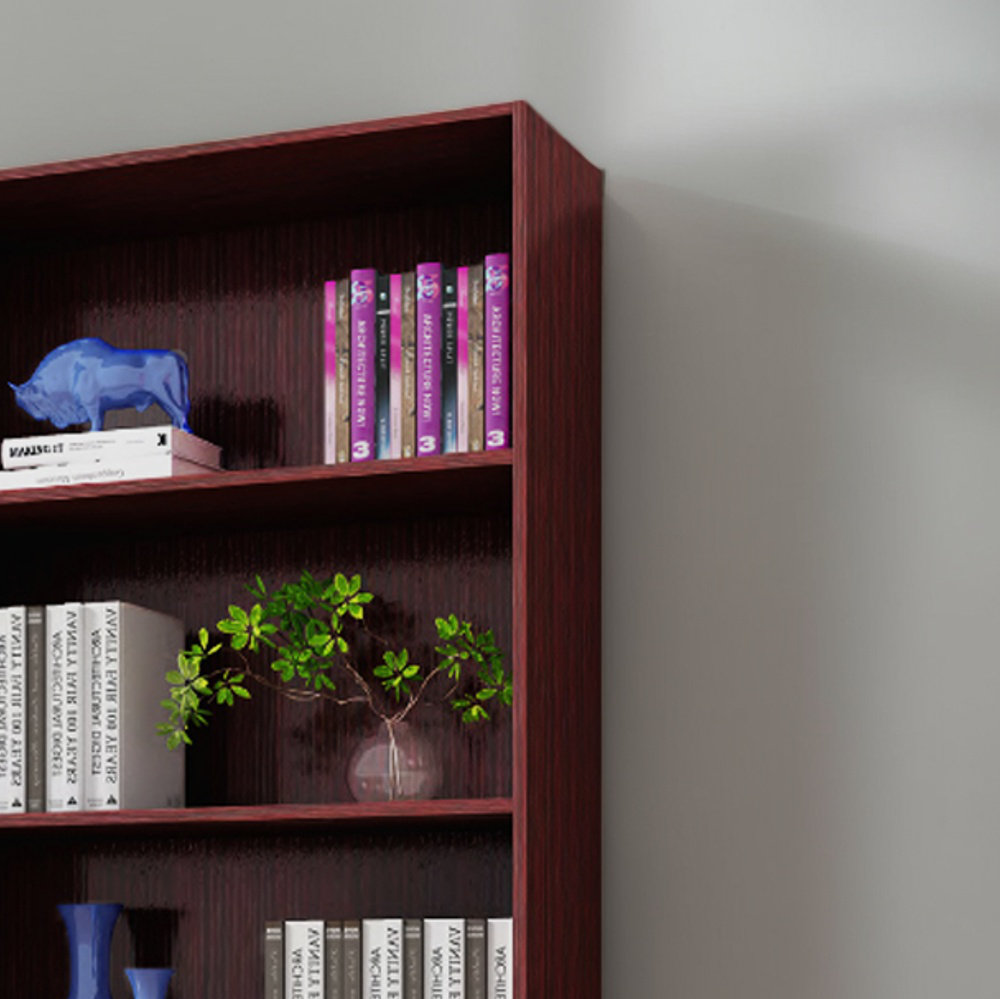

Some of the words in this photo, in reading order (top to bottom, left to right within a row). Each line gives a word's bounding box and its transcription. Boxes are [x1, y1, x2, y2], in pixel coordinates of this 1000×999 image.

[419, 436, 436, 452] 3
[488, 430, 504, 447] 3
[353, 441, 370, 459] 3
